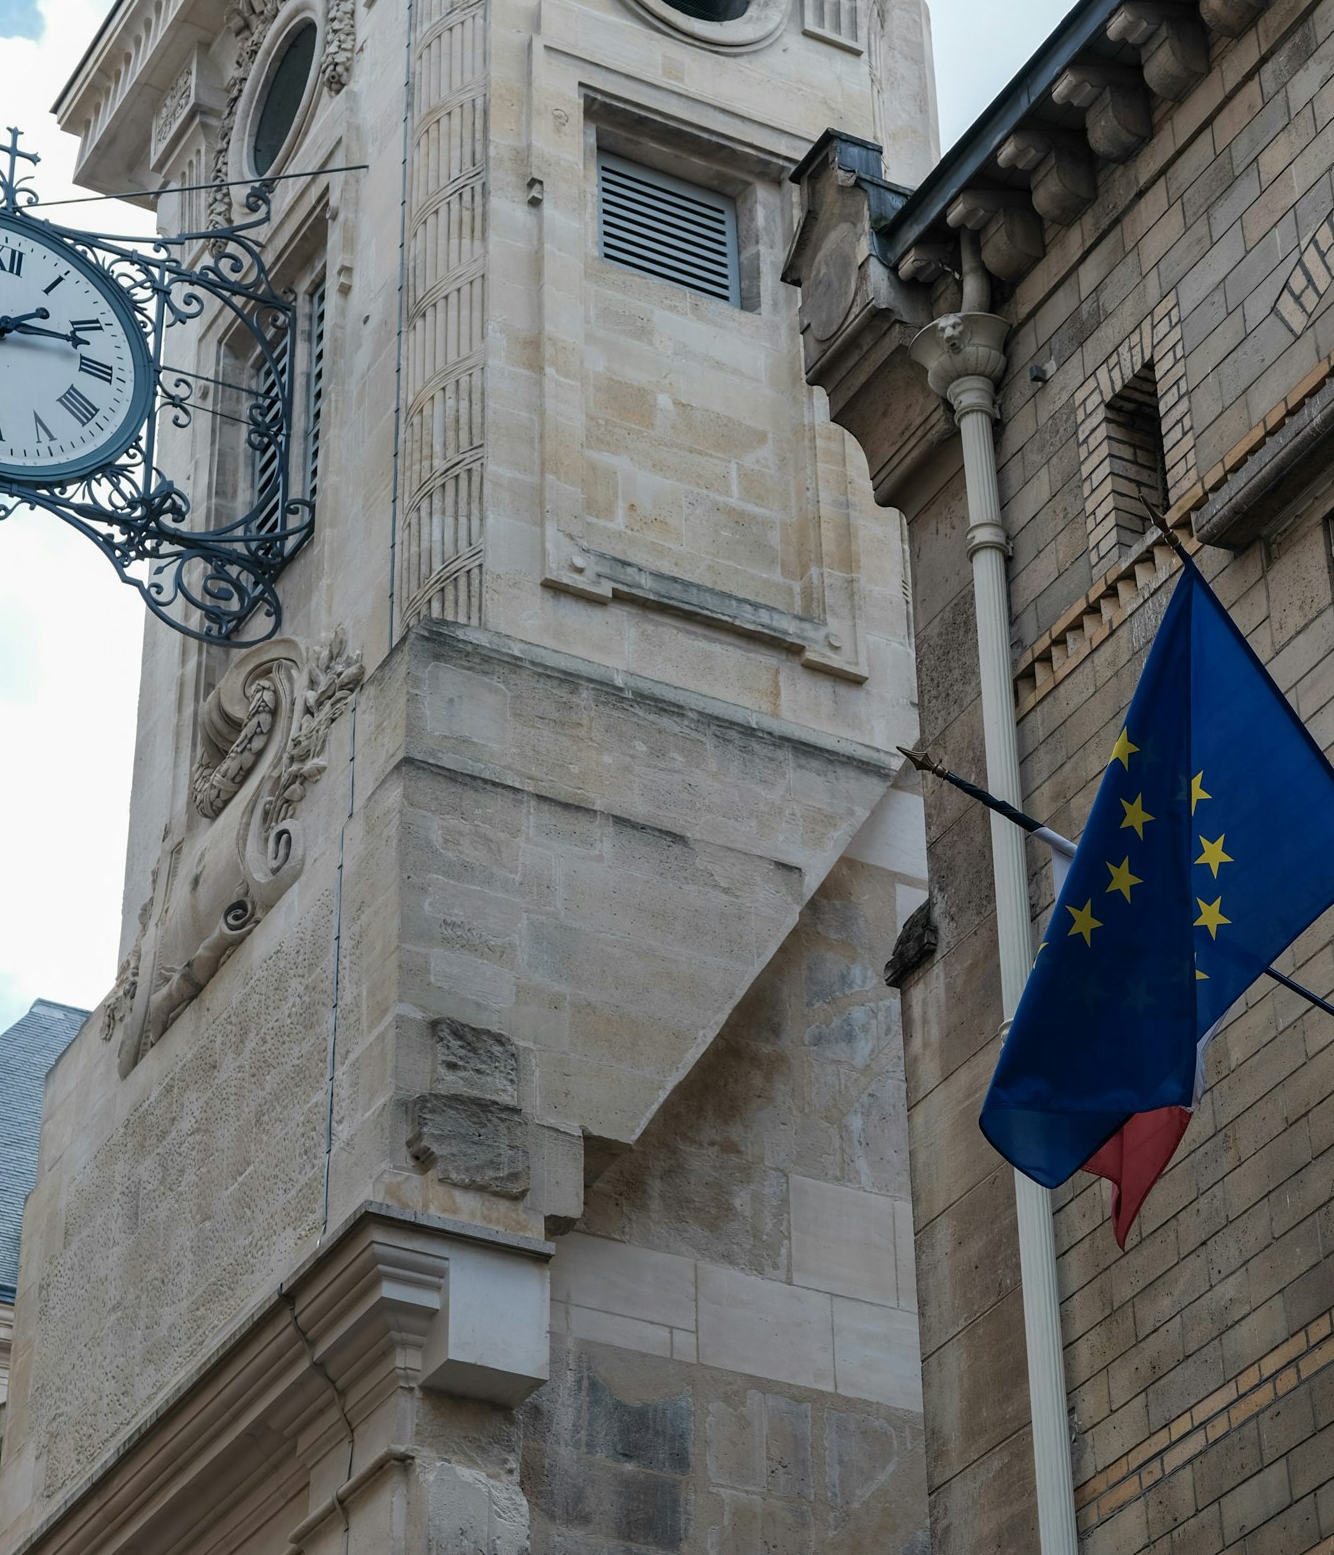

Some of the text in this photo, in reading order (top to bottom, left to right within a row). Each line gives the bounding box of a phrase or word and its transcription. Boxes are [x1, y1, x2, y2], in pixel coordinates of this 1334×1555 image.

[69, 318, 105, 332] II
[78, 353, 113, 385] III
[33, 409, 58, 443] V
